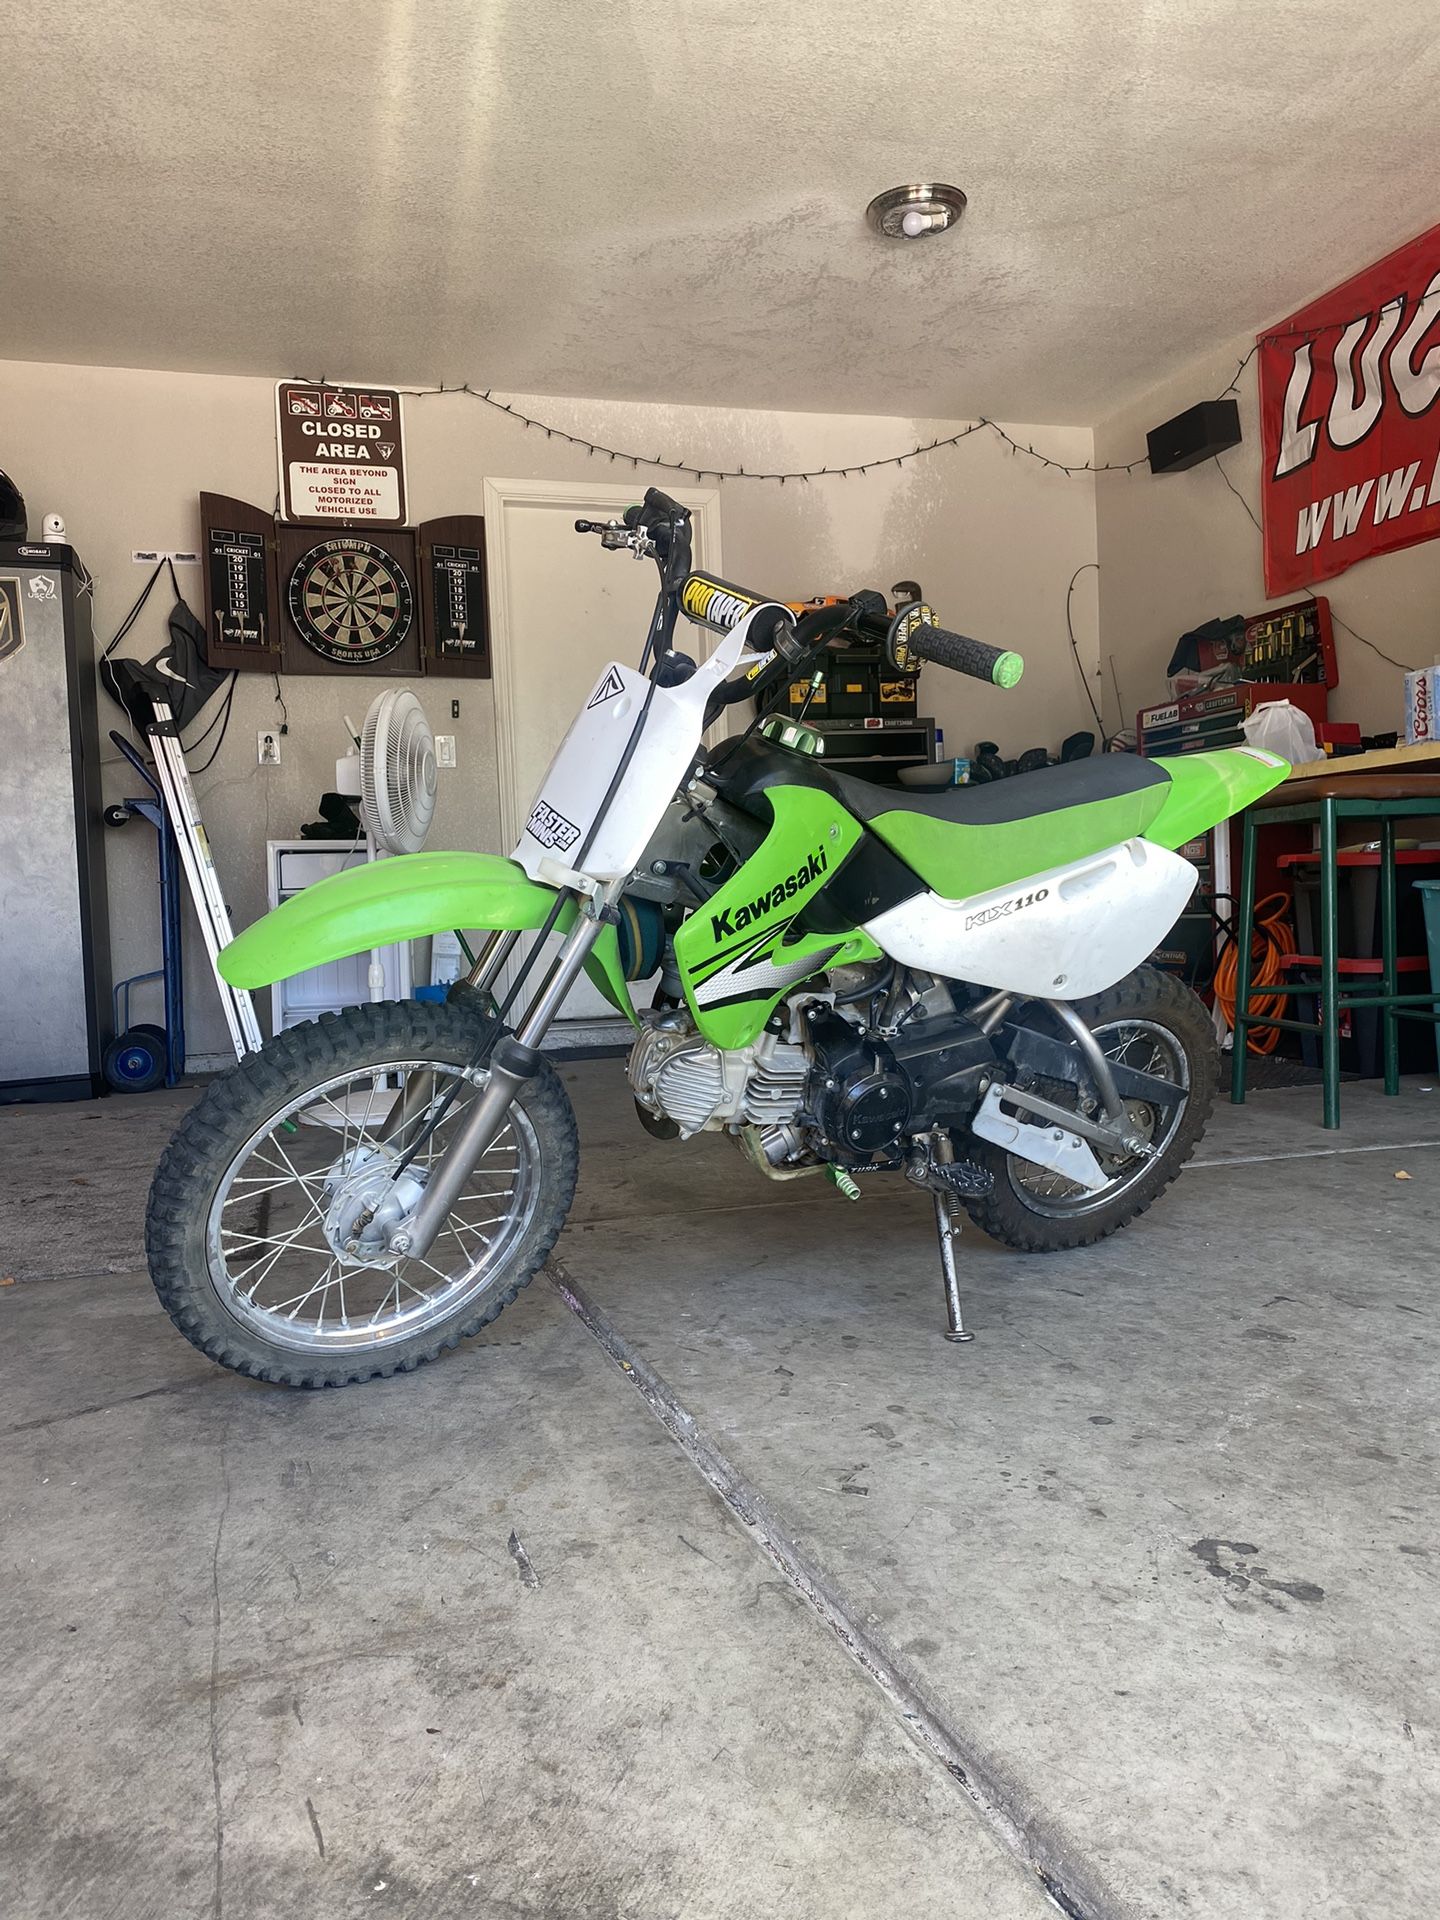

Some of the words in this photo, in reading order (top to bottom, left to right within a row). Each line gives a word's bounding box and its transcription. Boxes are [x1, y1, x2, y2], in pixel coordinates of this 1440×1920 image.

[302, 421, 381, 439] CLOSED
[315, 442, 371, 459] AREA
[300, 466, 319, 474] THE
[322, 468, 347, 476] AREA
[350, 469, 388, 477] BEYOND
[308, 486, 346, 494] CLOSED
[364, 488, 382, 496] ALL
[318, 496, 373, 505] MOTORIZED
[315, 506, 356, 514] VEHICLE
[358, 507, 377, 515] USE
[234, 564, 244, 572] 19
[234, 582, 244, 590] 17
[454, 586, 463, 594] 18
[235, 600, 245, 608] 15
[1414, 676, 1428, 737] Coors
[1150, 709, 1178, 722] FUELAB
[532, 802, 580, 844] FASTER
[528, 816, 559, 848] MINIS
[710, 844, 828, 944] Kawasaki
